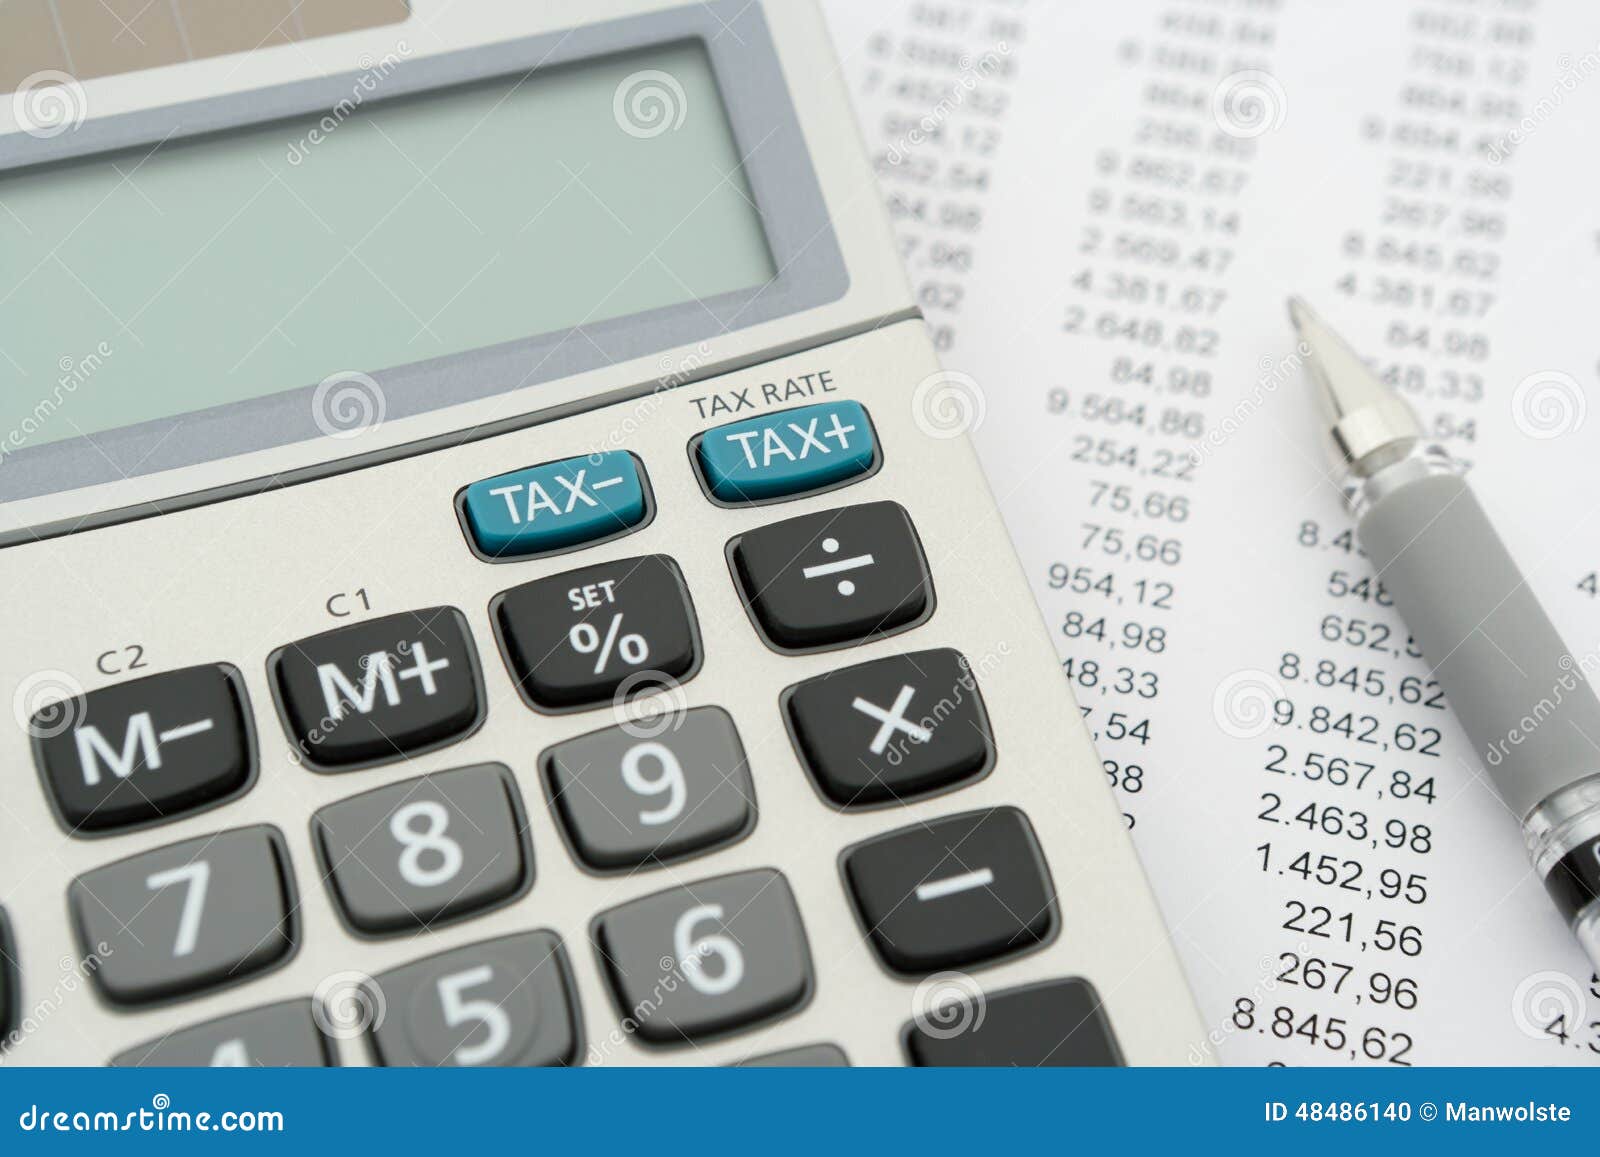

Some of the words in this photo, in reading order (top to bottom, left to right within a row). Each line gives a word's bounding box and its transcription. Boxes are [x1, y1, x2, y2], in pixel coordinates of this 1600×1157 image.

[690, 389, 757, 419] TAX
[761, 370, 837, 405] RATE
[1110, 355, 1213, 400] 84,98
[726, 413, 856, 470] TAX+
[1070, 433, 1196, 483] 254,22
[1089, 480, 1191, 524] 75,66
[1080, 523, 1183, 567] 75,66
[326, 588, 372, 618] C1
[568, 580, 617, 611] SET
[1048, 562, 1175, 610] 954,12
[96, 645, 148, 675] C2
[568, 613, 649, 674] %
[1062, 611, 1167, 654] 84,98
[317, 641, 450, 720] M+
[1278, 652, 1447, 711] 8.845,62
[1272, 699, 1443, 757] 9.842,62
[621, 742, 688, 825] 9
[1264, 744, 1438, 804] 2.567,84
[390, 801, 464, 887] 8
[1257, 792, 1433, 854] 2.463,98
[1256, 843, 1429, 904] 1.452,95
[146, 860, 210, 958] 7
[1281, 900, 1424, 957] 221,56
[673, 904, 744, 995] 6
[1276, 952, 1419, 1010] 267,96
[437, 965, 512, 1066] 5
[1232, 997, 1415, 1067] 8.845,62
